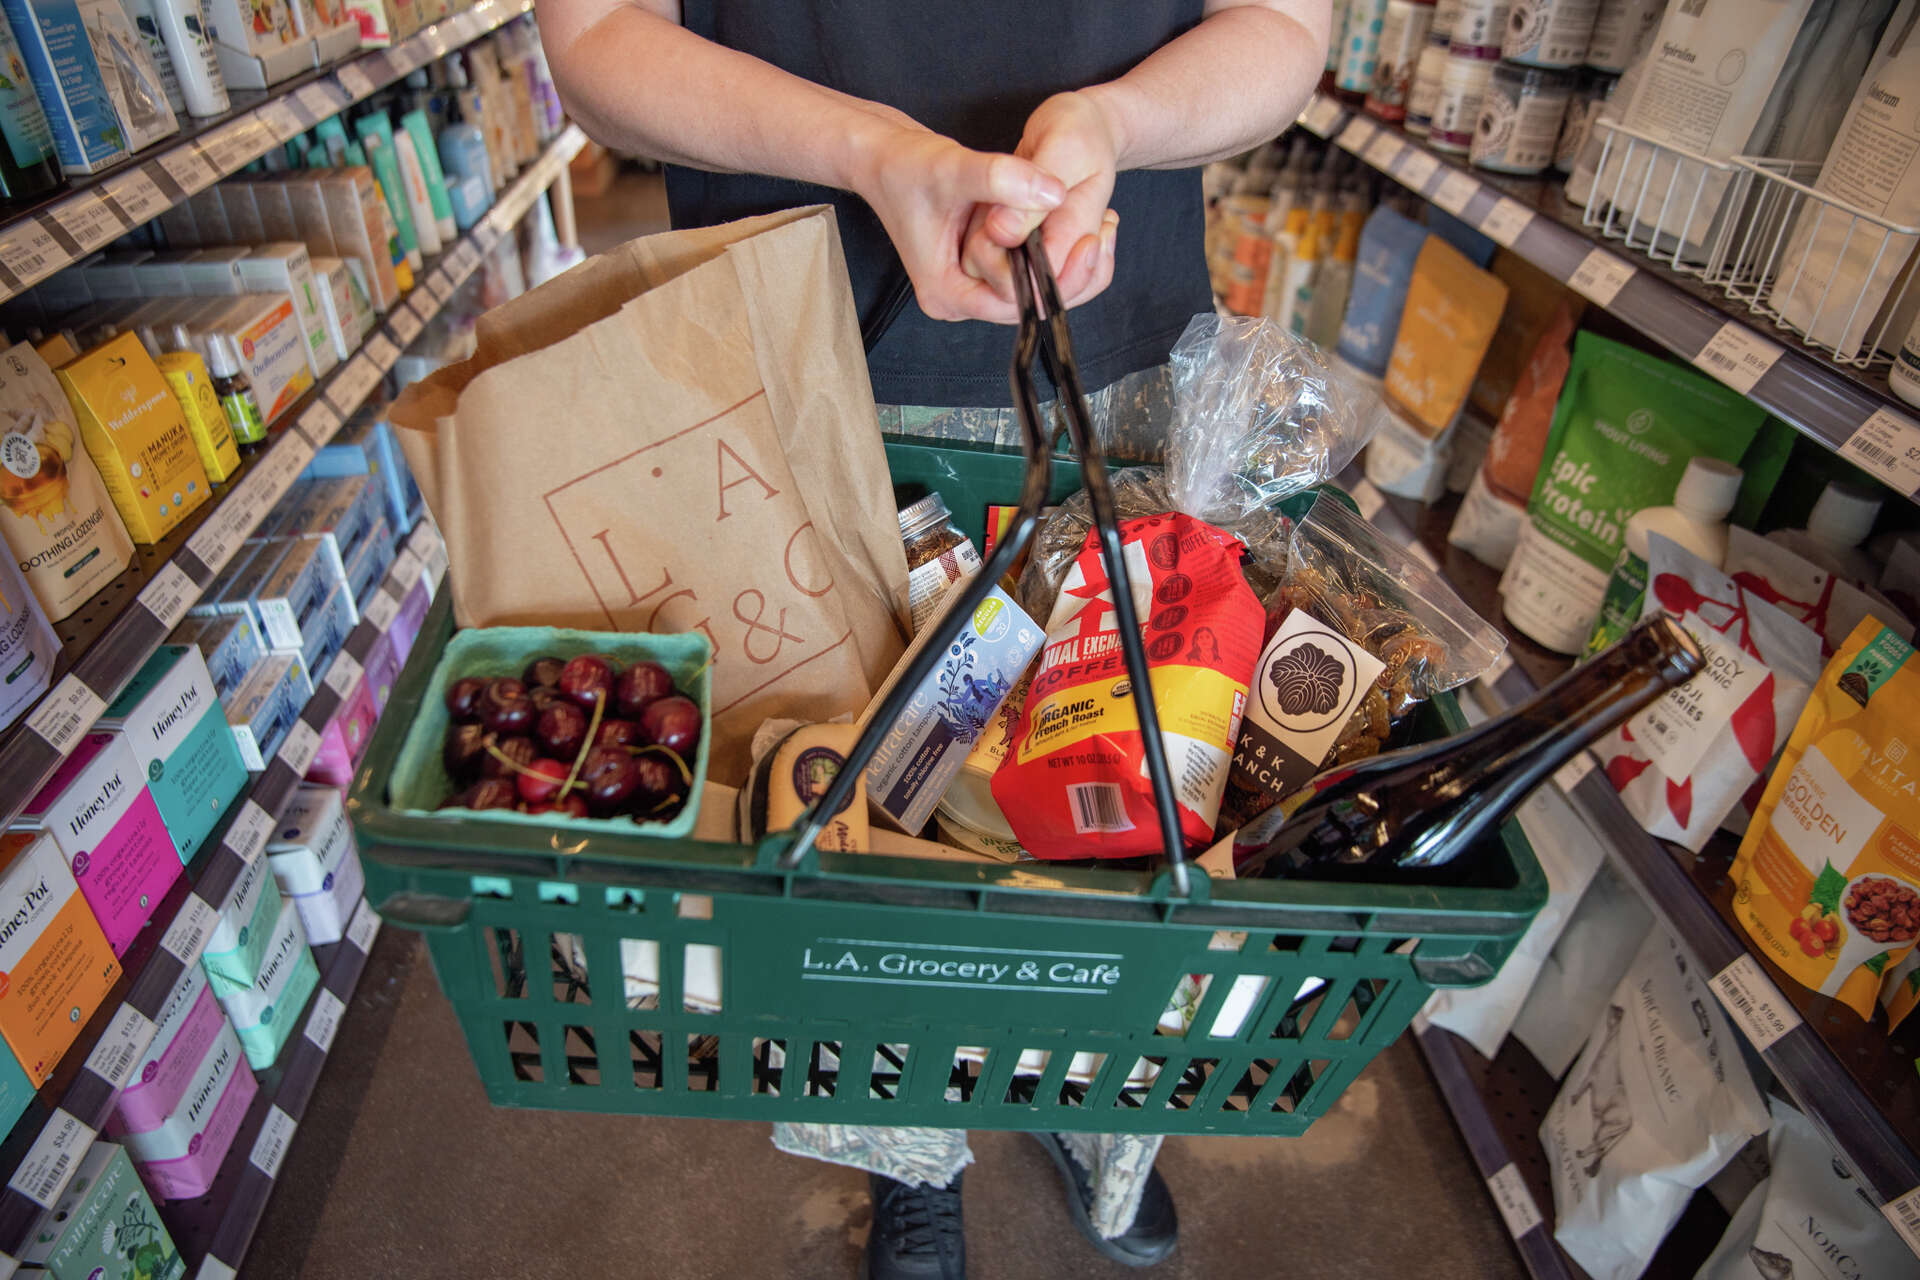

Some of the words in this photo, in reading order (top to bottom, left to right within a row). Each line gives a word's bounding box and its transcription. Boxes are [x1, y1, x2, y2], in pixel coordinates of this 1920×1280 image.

[107, 389, 167, 431] Wedderspoon
[147, 423, 186, 454] MANUKA
[717, 439, 780, 522] A
[18, 535, 73, 573] OOTHING
[592, 529, 672, 607] L
[732, 588, 805, 664] &
[784, 521, 834, 598] C
[976, 600, 998, 629] REGULAR
[1035, 642, 1080, 681] QUAL
[1083, 624, 1149, 656] EXCHAE
[1879, 639, 1905, 661] FOODS
[1035, 654, 1130, 695] COFFE
[1681, 682, 1704, 702] OJI
[1703, 664, 1733, 690] ANIC
[152, 703, 184, 741] Honey
[180, 685, 198, 710] Pot
[1037, 699, 1095, 725] ORGANIC
[1071, 707, 1104, 730] Roast
[1667, 689, 1704, 723] RRIES
[875, 758, 899, 793] organic
[896, 730, 921, 769] cotton
[911, 703, 939, 743] tampons
[902, 763, 919, 785] 100%
[914, 745, 932, 768] cotton
[1240, 732, 1255, 748] K
[1254, 744, 1267, 759] &
[1270, 755, 1286, 771] K
[1851, 734, 1920, 800] NAVITA
[903, 776, 923, 801] totally
[918, 753, 938, 782] chlorine
[932, 742, 944, 760] free
[1233, 752, 1284, 793] ANCH
[69, 796, 105, 836] Honey
[102, 773, 122, 799] Pot
[1788, 773, 1847, 845] GOLDEN
[109, 819, 147, 864] organically
[0, 902, 30, 949] oney
[24, 879, 49, 911] Pot
[33, 923, 74, 976] organically
[57, 939, 83, 976] tampons
[257, 951, 284, 992] Honey
[280, 928, 296, 955] Pot
[803, 948, 869, 973] L.A.
[879, 953, 1009, 984] Grocery
[1015, 961, 1041, 982] &
[1049, 962, 1121, 985] Café
[30, 967, 51, 996] grown
[1759, 1002, 1785, 1034] $16.99
[188, 1076, 216, 1123] Honey
[213, 1048, 229, 1076] Pot
[1650, 1033, 1682, 1103] ORGANIC
[54, 1118, 76, 1149] $34.99
[55, 1160, 123, 1268] natracare
[1800, 1214, 1866, 1280] NORCA
